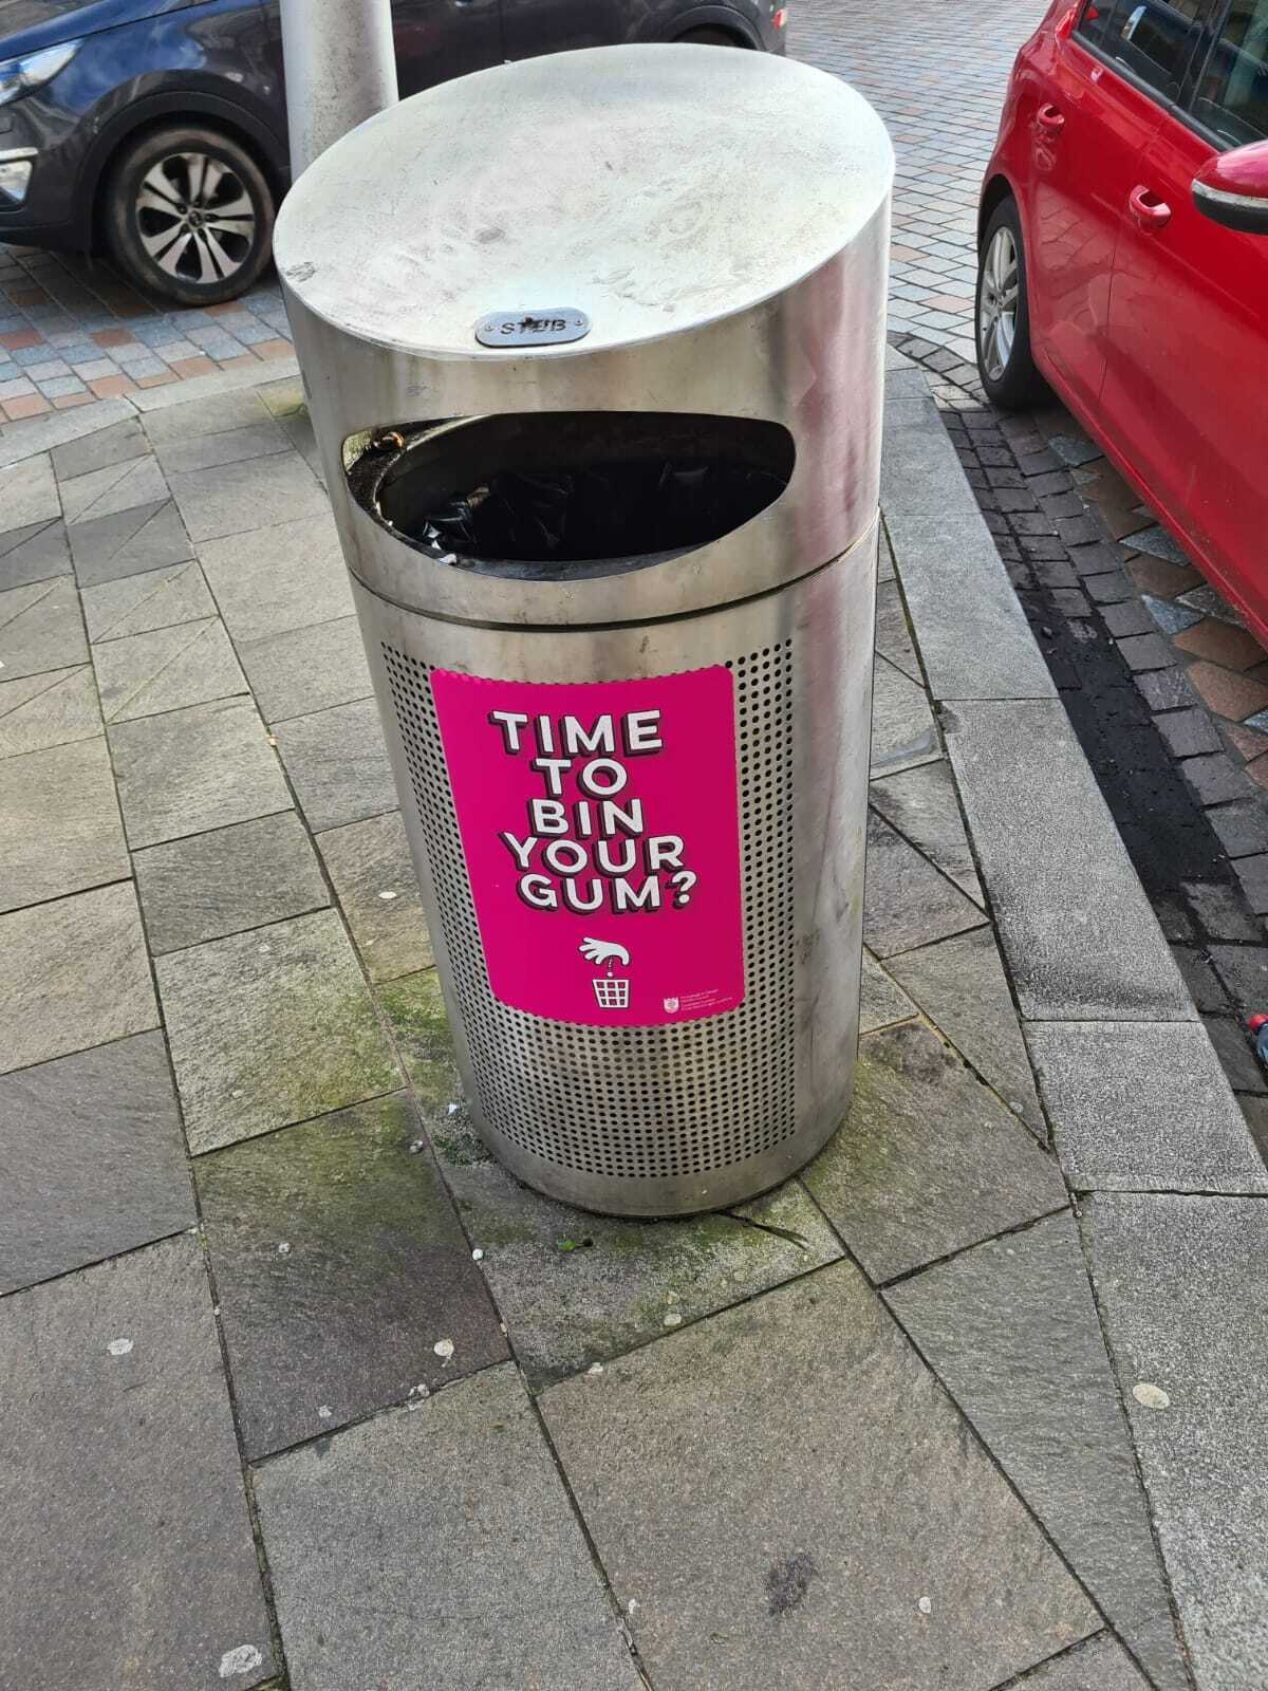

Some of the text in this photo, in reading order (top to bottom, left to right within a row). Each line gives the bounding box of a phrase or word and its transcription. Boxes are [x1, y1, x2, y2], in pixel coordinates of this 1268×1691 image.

[488, 710, 663, 756] TIME
[531, 757, 628, 799] TO
[529, 798, 645, 839] BIN
[499, 832, 685, 877] YOUR
[517, 870, 698, 914] GUM?
